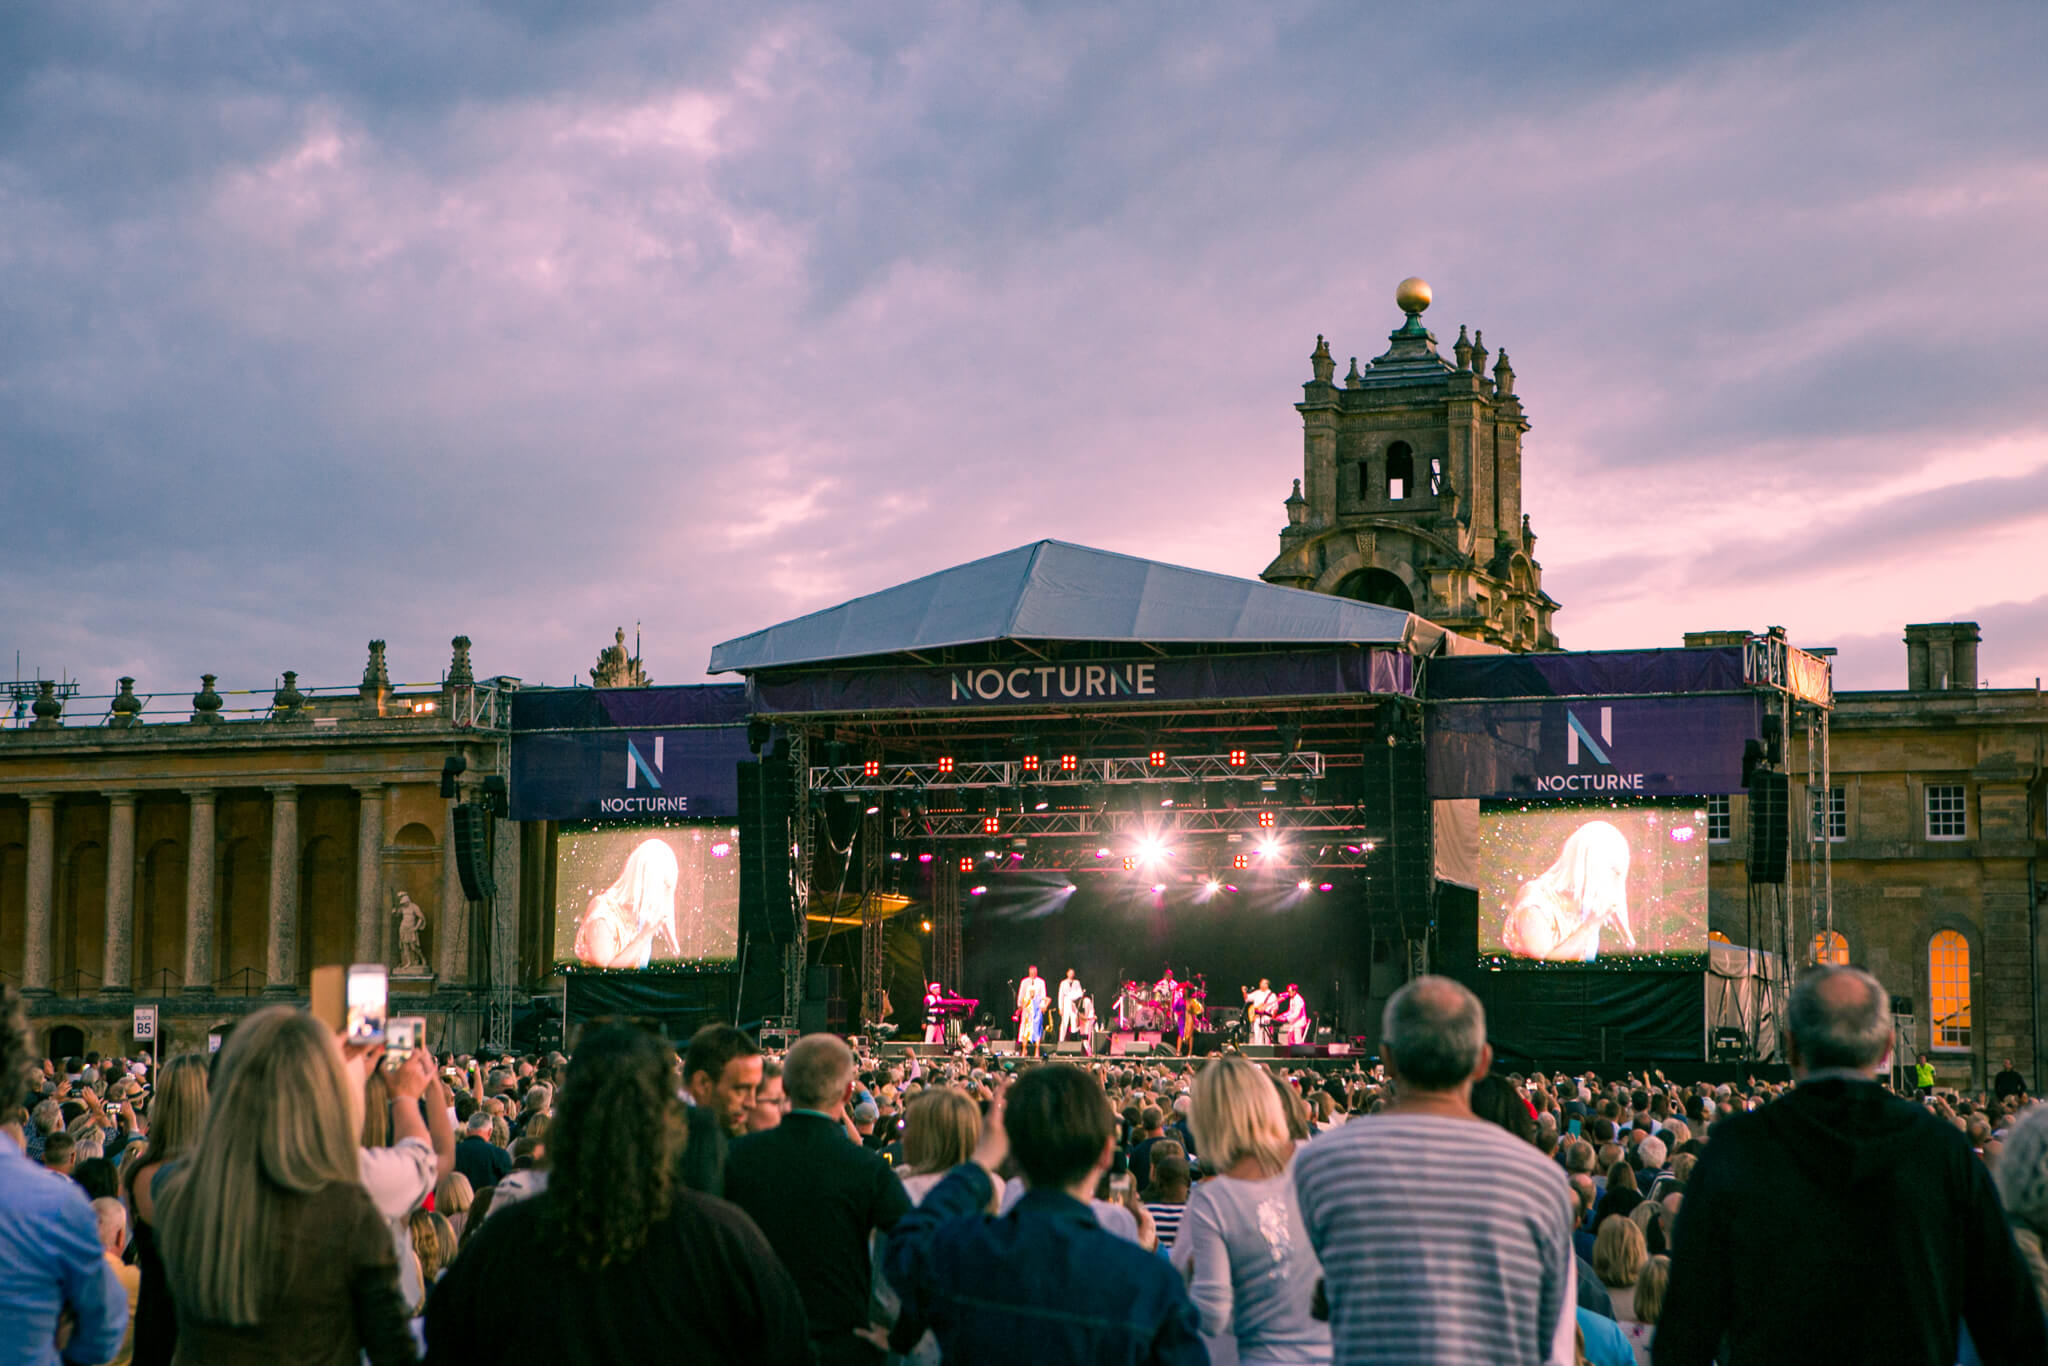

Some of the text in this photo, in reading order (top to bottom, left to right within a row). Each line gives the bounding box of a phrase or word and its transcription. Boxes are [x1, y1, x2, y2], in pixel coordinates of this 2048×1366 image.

[951, 664, 1155, 700] NOCTURNE
[1567, 706, 1612, 765] N
[627, 736, 664, 789] N
[1537, 774, 1644, 791] NOCTURNE
[601, 797, 688, 812] NOCTURNE
[137, 1022, 151, 1034] B5
